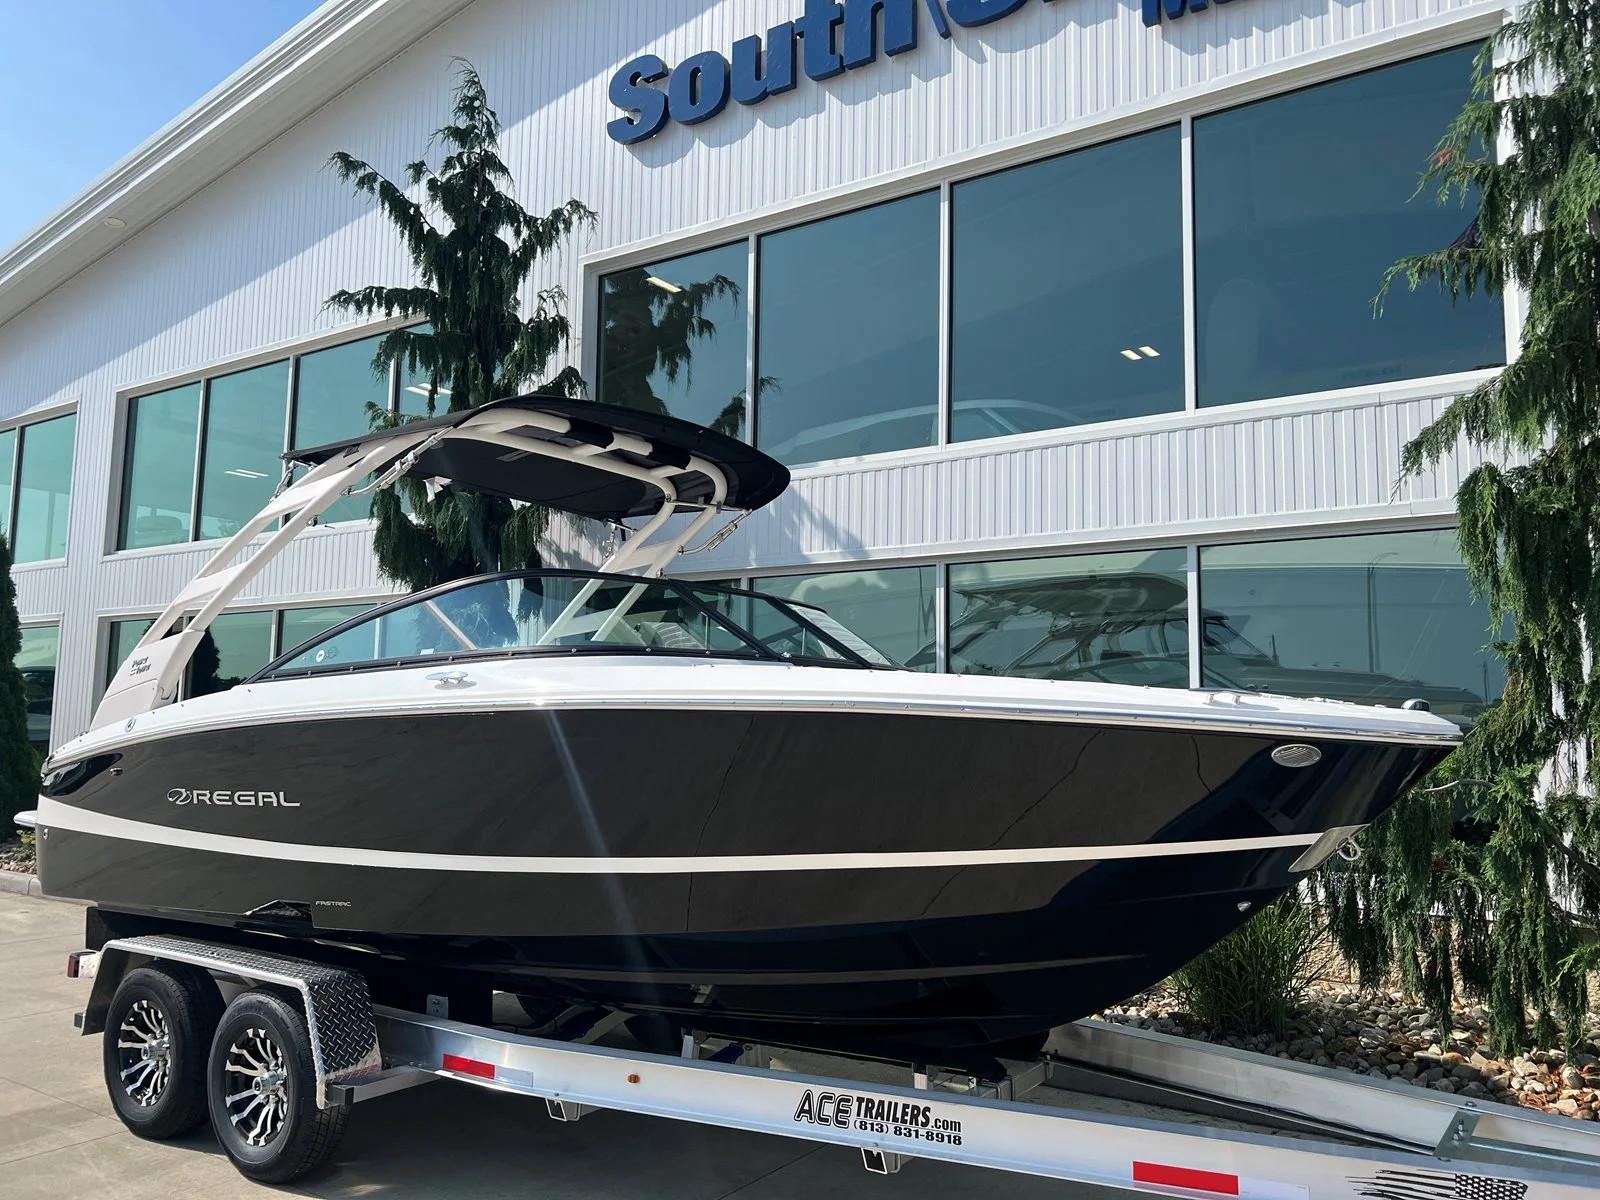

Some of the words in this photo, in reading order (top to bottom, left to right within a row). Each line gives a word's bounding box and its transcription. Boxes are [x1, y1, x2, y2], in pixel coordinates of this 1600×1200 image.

[606, 0, 917, 145] South
[192, 790, 301, 807] REGAL
[794, 1089, 853, 1128] ACE
[854, 1120, 889, 1134] (813)
[893, 1126, 962, 1146] 831-8918
